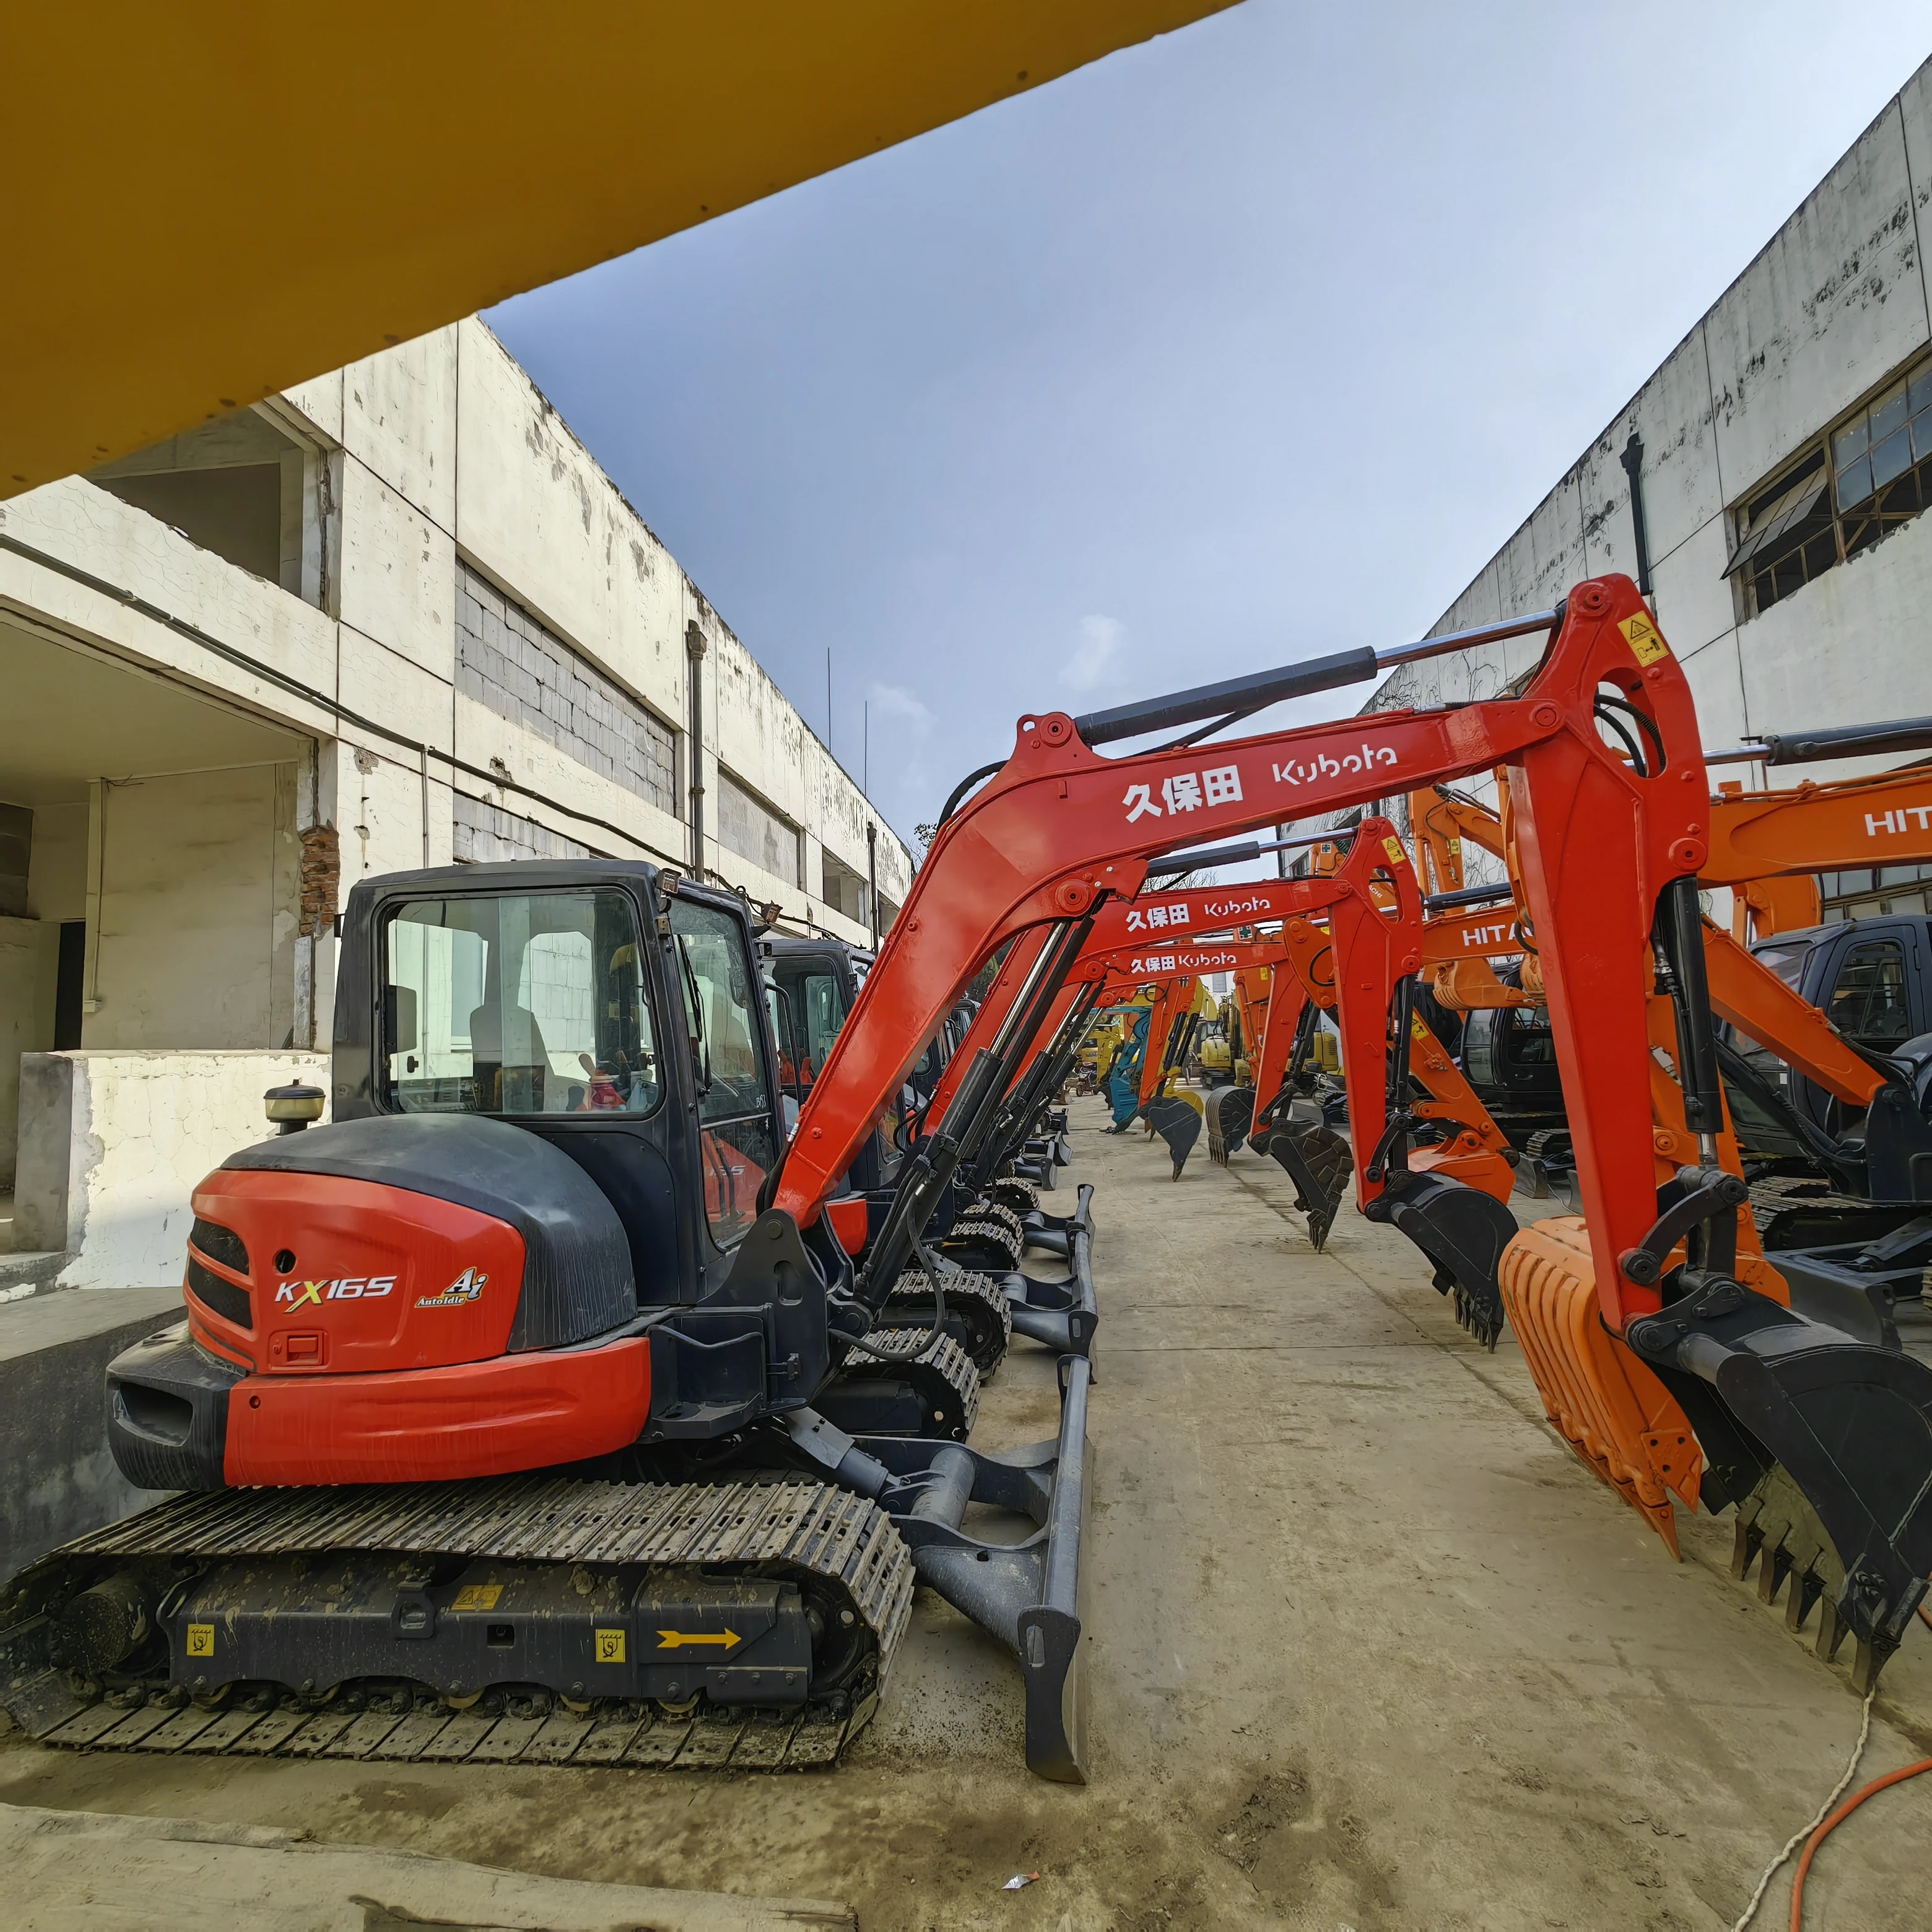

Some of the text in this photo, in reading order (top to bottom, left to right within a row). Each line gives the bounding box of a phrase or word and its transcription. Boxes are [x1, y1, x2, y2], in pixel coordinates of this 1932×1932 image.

[1122, 744, 1397, 823] 久保田 Kubota
[1865, 806, 1932, 836] HIT
[1126, 897, 1271, 932] 久保田 Kubota
[1131, 952, 1237, 974] 久保田 Kubota
[275, 1276, 398, 1313] KX165
[445, 1268, 487, 1300] Ai
[417, 1296, 465, 1306] AutoIdle
